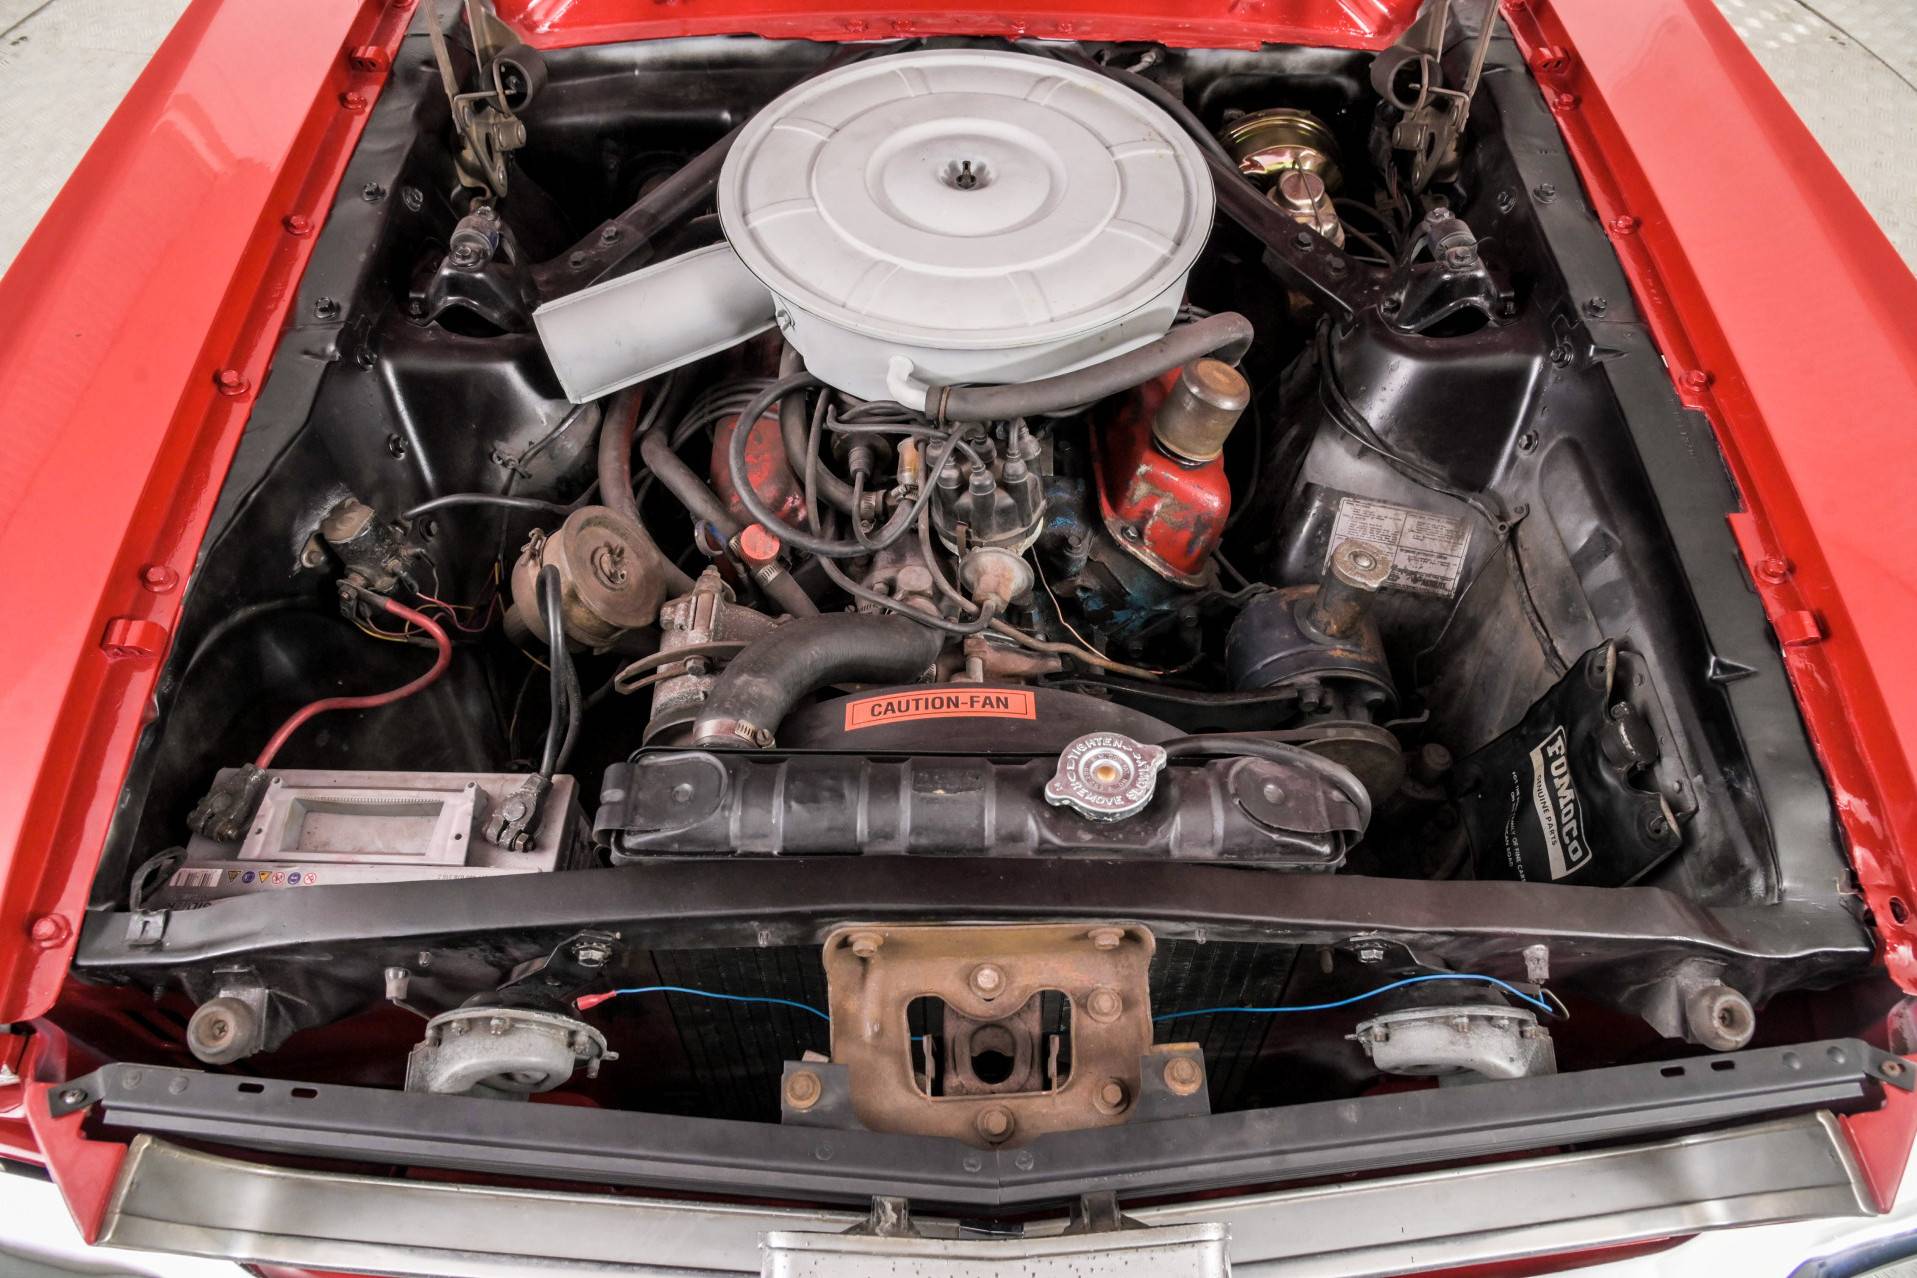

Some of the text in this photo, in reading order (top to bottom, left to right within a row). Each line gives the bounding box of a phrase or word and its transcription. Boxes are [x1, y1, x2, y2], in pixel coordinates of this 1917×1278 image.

[870, 695, 1009, 717] CAUTION-FAN
[1067, 737, 1123, 760] TIGHTEN
[1070, 781, 1125, 806] REMOVE
[1536, 774, 1558, 846] GENUINE PARTS
